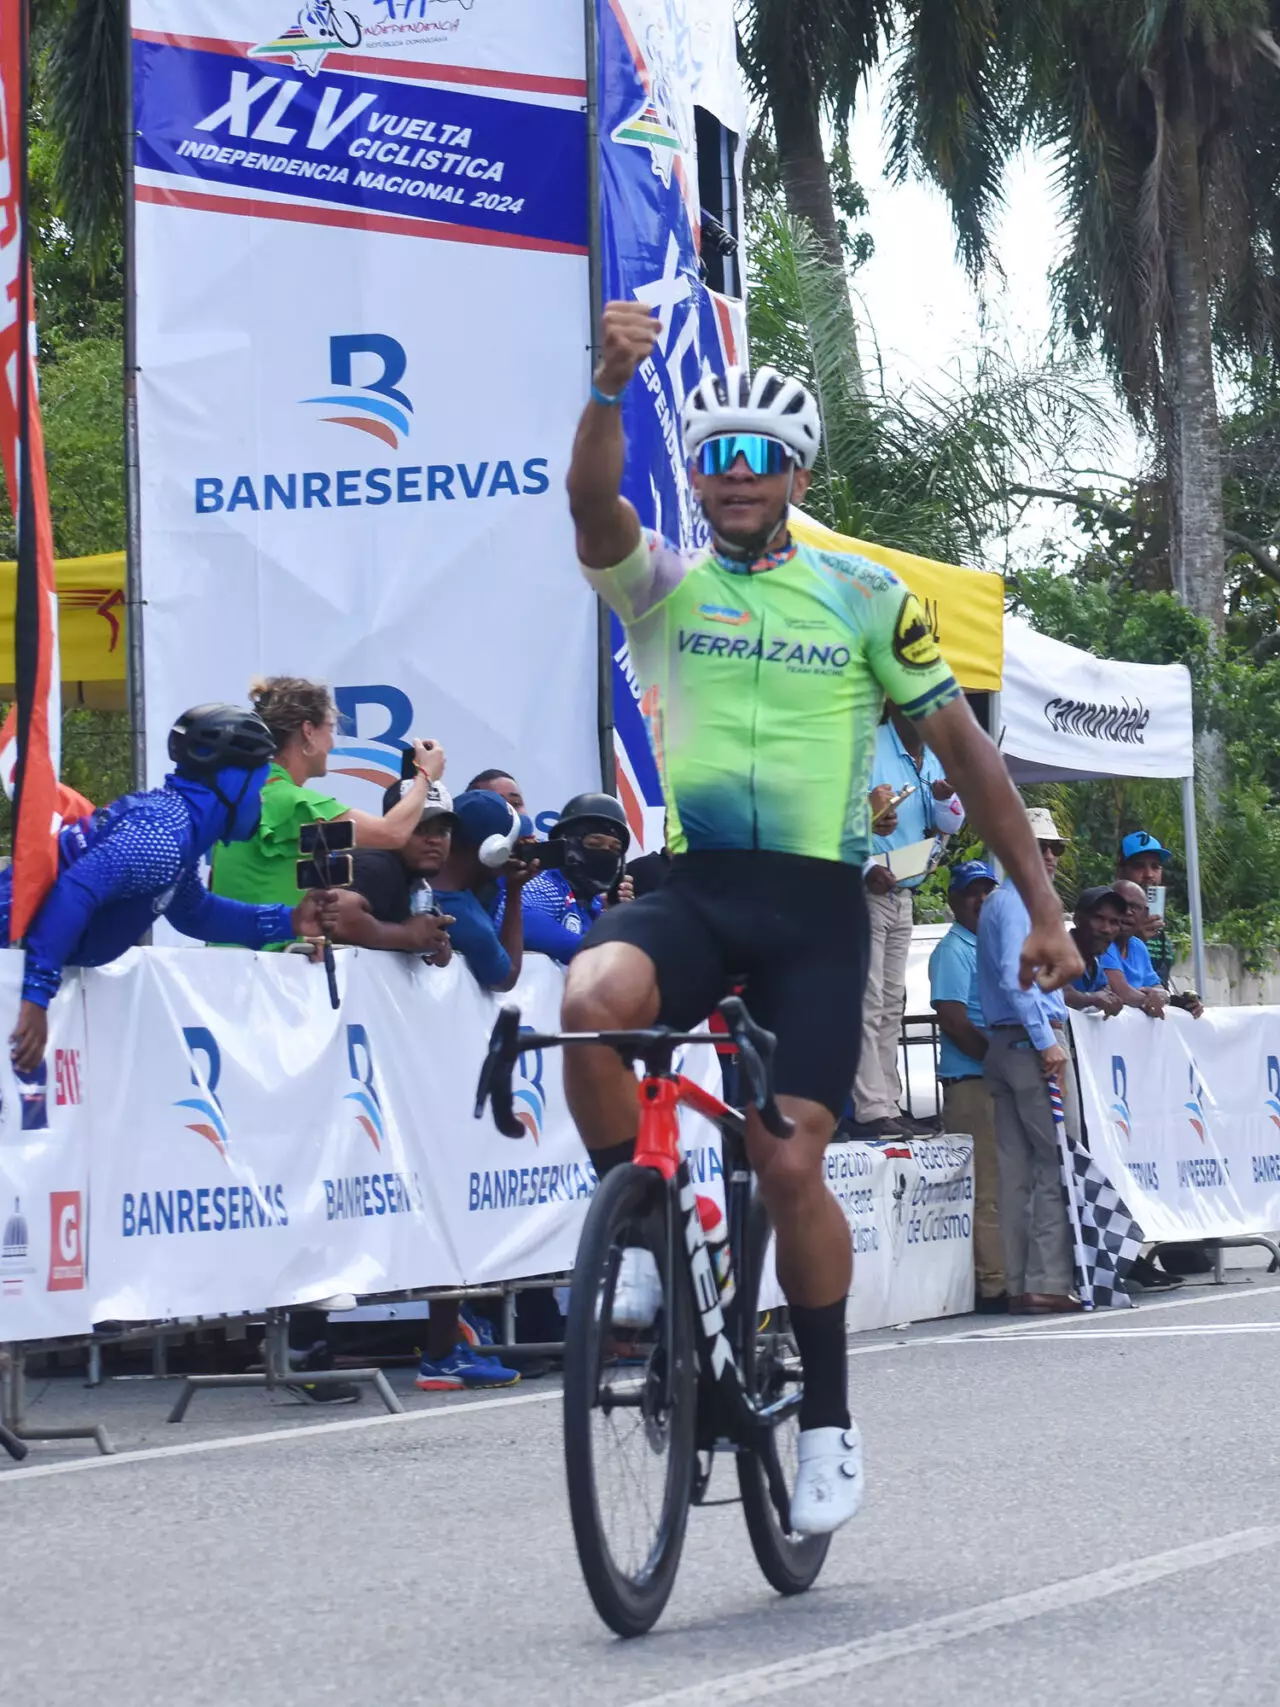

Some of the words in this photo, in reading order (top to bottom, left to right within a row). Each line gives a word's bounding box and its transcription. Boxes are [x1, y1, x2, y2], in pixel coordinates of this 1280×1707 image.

[193, 70, 379, 151] XLV
[367, 112, 473, 149] VUELTA
[175, 139, 350, 185] INDEPENDENCIA
[352, 170, 466, 206] NACIONAL
[469, 190, 525, 215] 2024
[347, 137, 505, 183] CICLISTICA
[194, 457, 550, 514] BANRESERVAS
[678, 629, 852, 668] VERRAZANO
[1044, 695, 1150, 745] cannondale
[121, 1183, 289, 1237] BANRESERVAS
